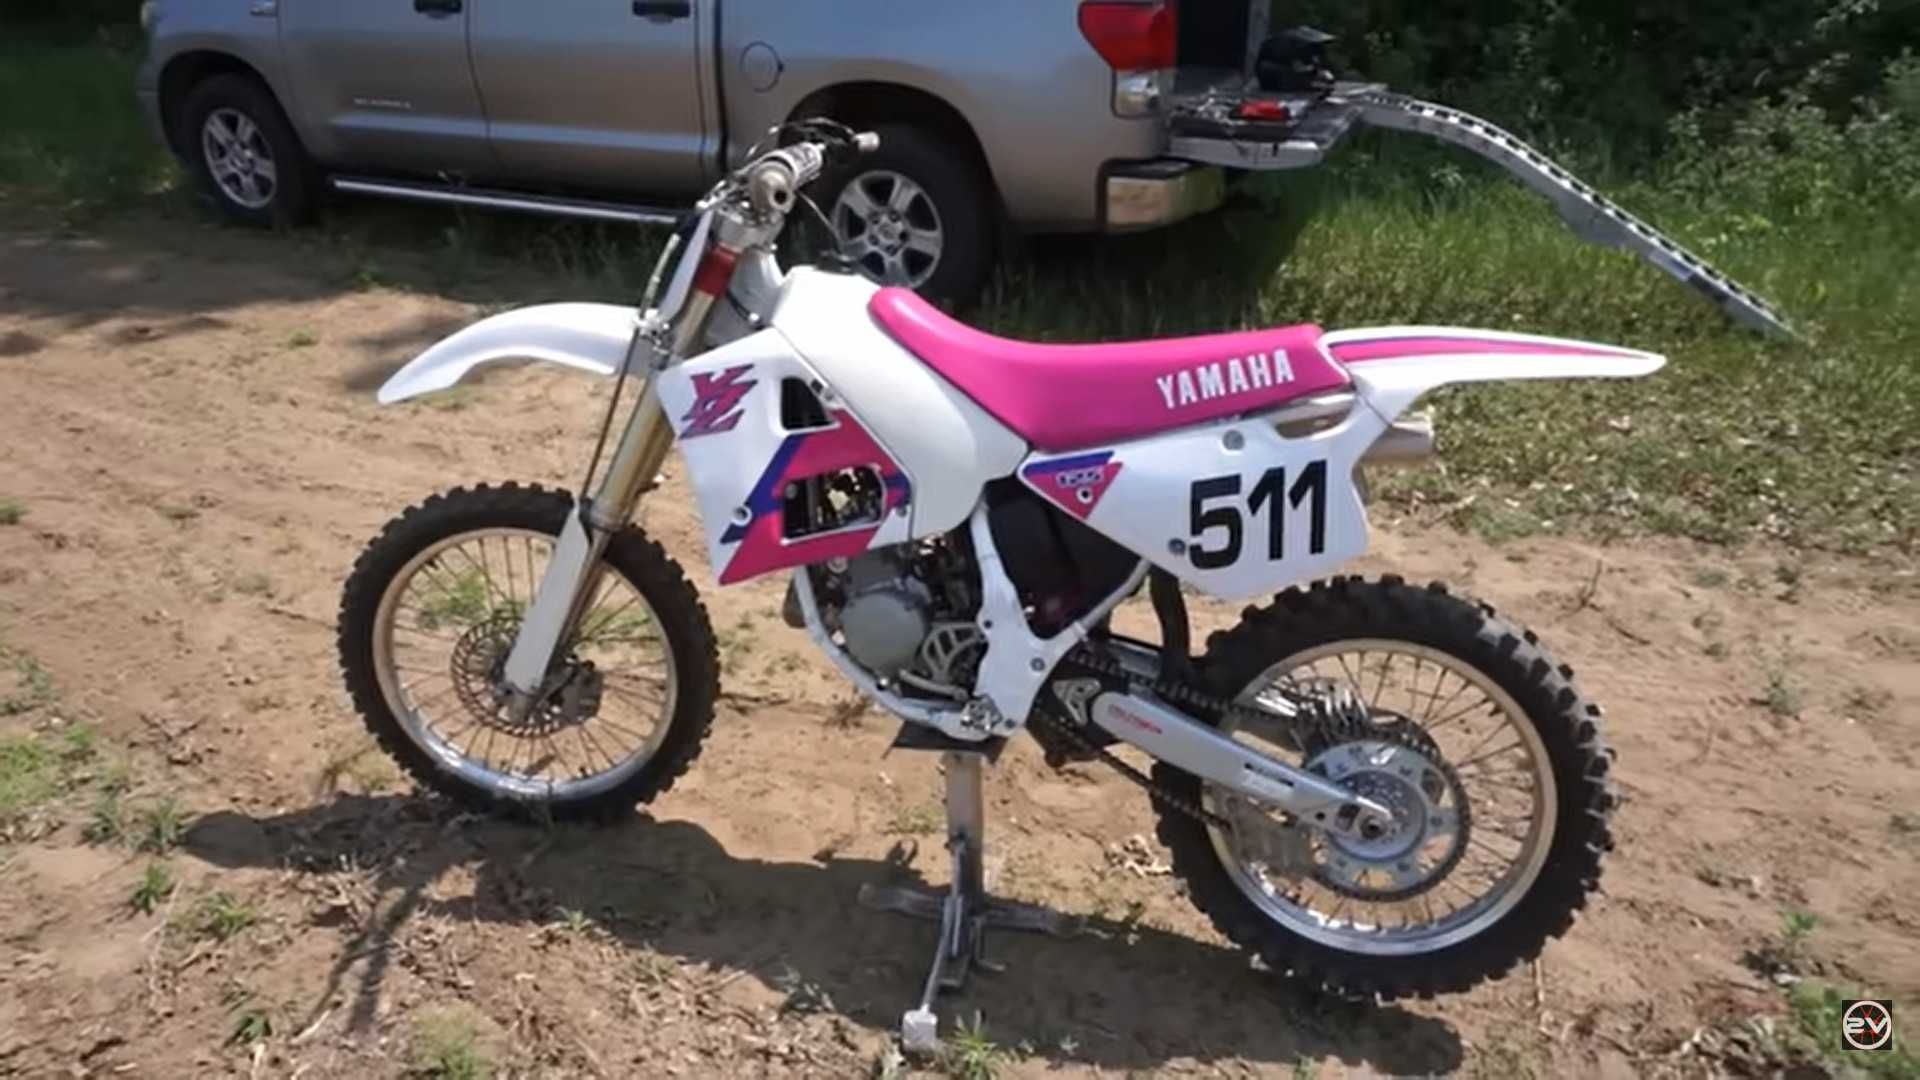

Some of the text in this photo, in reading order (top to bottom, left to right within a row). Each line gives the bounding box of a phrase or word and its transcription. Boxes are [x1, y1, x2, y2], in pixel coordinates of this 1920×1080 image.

[679, 363, 758, 439] YZ
[1156, 348, 1295, 409] YAMAHA
[1189, 459, 1327, 570] 511
